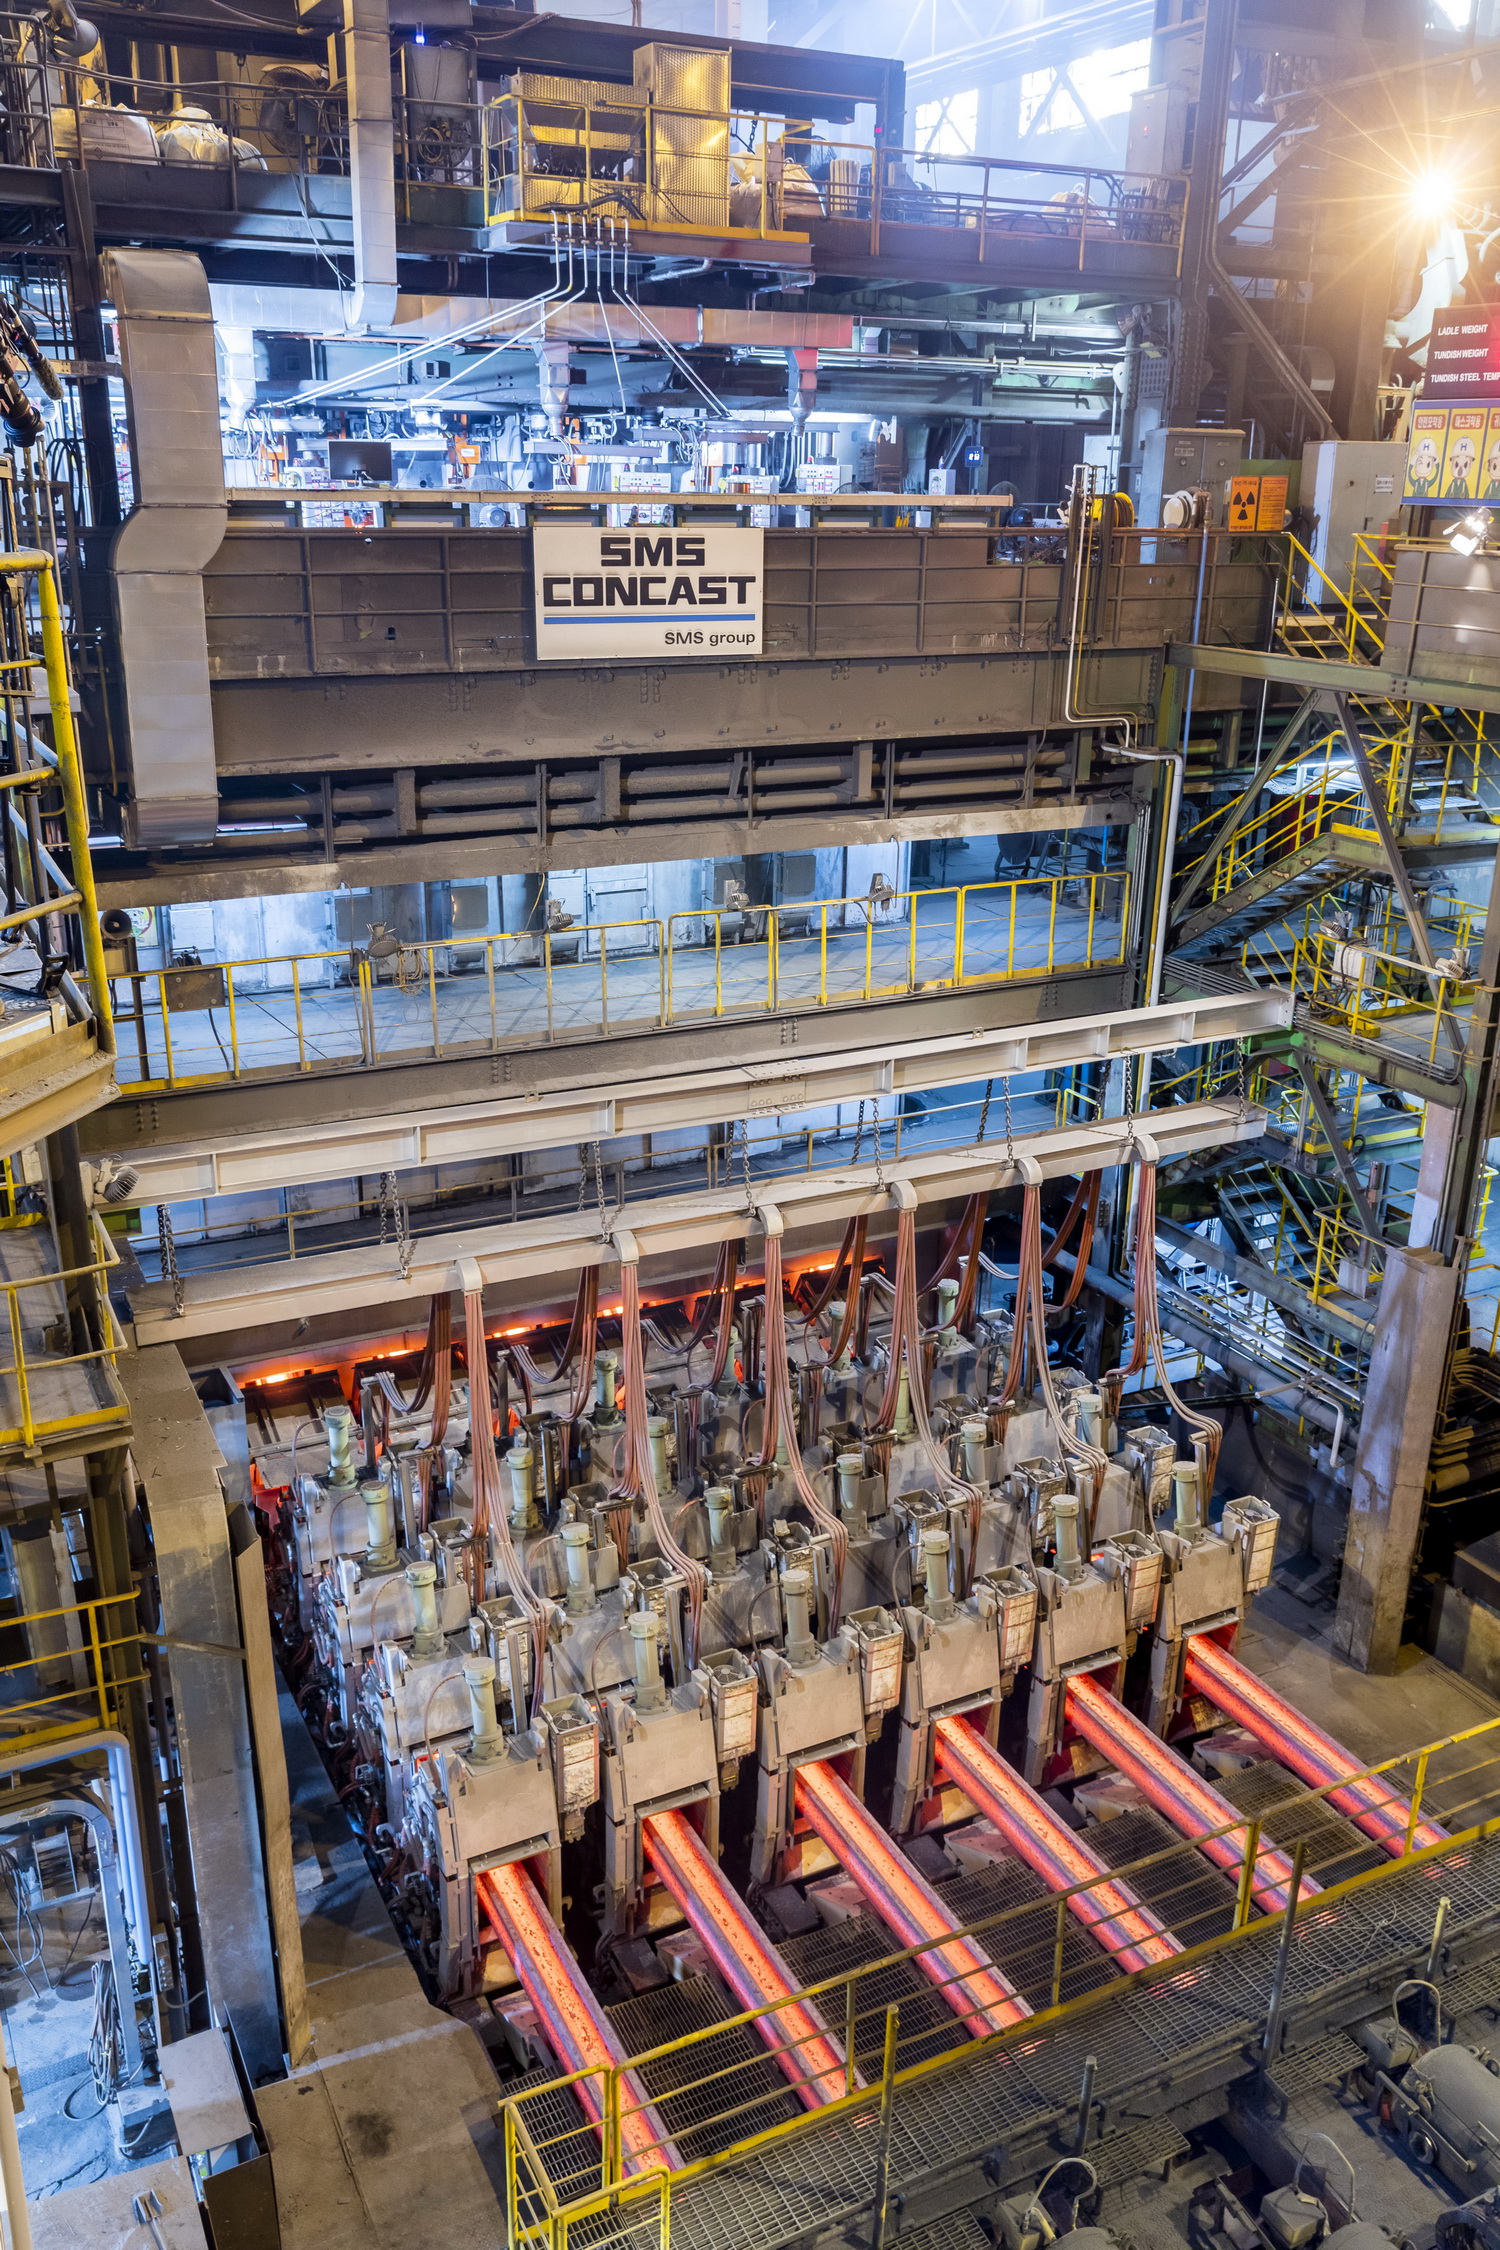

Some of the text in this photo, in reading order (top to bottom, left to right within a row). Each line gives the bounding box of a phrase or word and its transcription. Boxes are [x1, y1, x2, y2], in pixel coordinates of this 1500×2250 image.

[1438, 324, 1489, 336] LADLE WEIGHT
[1434, 348, 1489, 360] TUNDISH WEIGHT
[1431, 373, 1459, 383] TUNDISH
[1459, 372, 1481, 382] STEEL
[600, 536, 706, 567] SMS
[543, 575, 756, 607] CONCAST
[664, 631, 756, 646] SMS group
